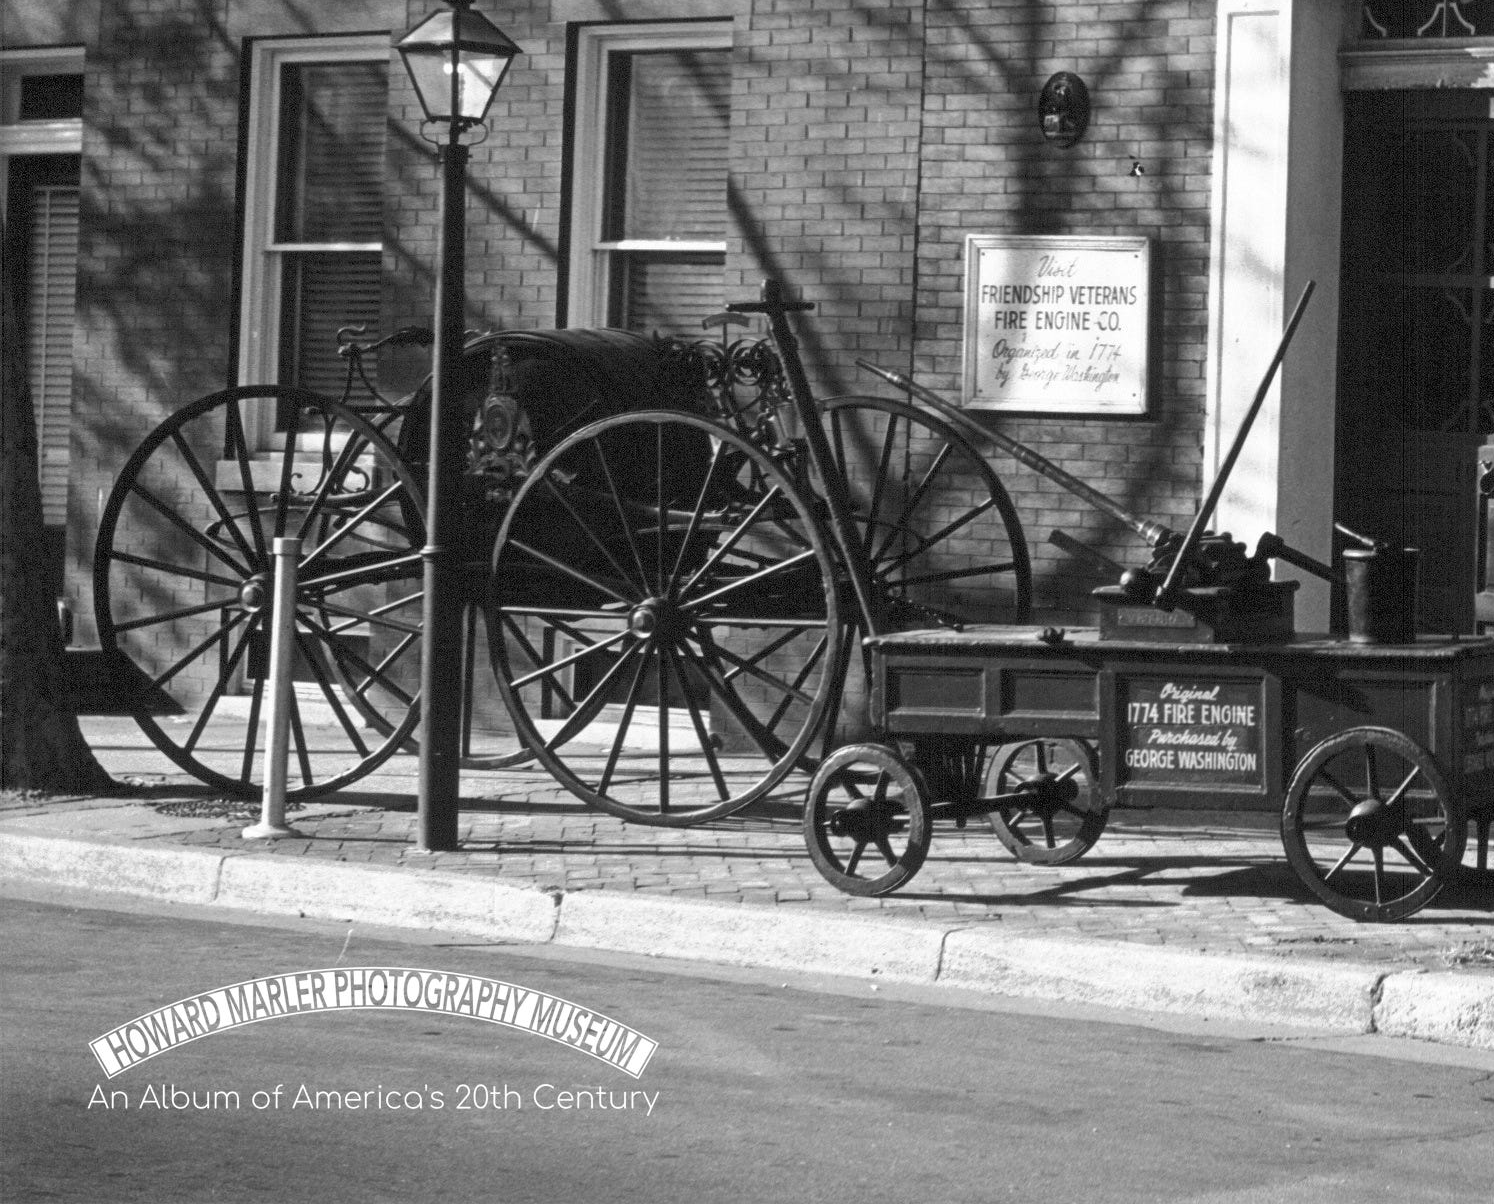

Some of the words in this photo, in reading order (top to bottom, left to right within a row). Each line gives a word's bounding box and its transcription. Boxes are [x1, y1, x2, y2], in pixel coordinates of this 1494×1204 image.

[1036, 255, 1079, 278] Visit
[981, 284, 1065, 305] FRIENDSHIP
[1069, 285, 1137, 306] VETERANS
[994, 310, 1028, 330] FIRE
[1035, 311, 1091, 331] ENGINE
[1094, 311, 1122, 332] CO.
[992, 338, 1061, 365] Organized
[1066, 346, 1081, 361] in
[1088, 342, 1122, 361] 1774
[994, 362, 1012, 389] by
[1020, 362, 1058, 390] George
[1062, 363, 1121, 393] Washington
[1160, 682, 1220, 704] Original
[1127, 702, 1160, 724] 1774
[1163, 703, 1196, 725] FIRE
[1201, 704, 1256, 727] ENGINE
[1147, 728, 1223, 747] Purchased
[1221, 728, 1238, 752] by
[1125, 748, 1176, 769] GEORGE
[1178, 750, 1257, 771] WASHINGTON
